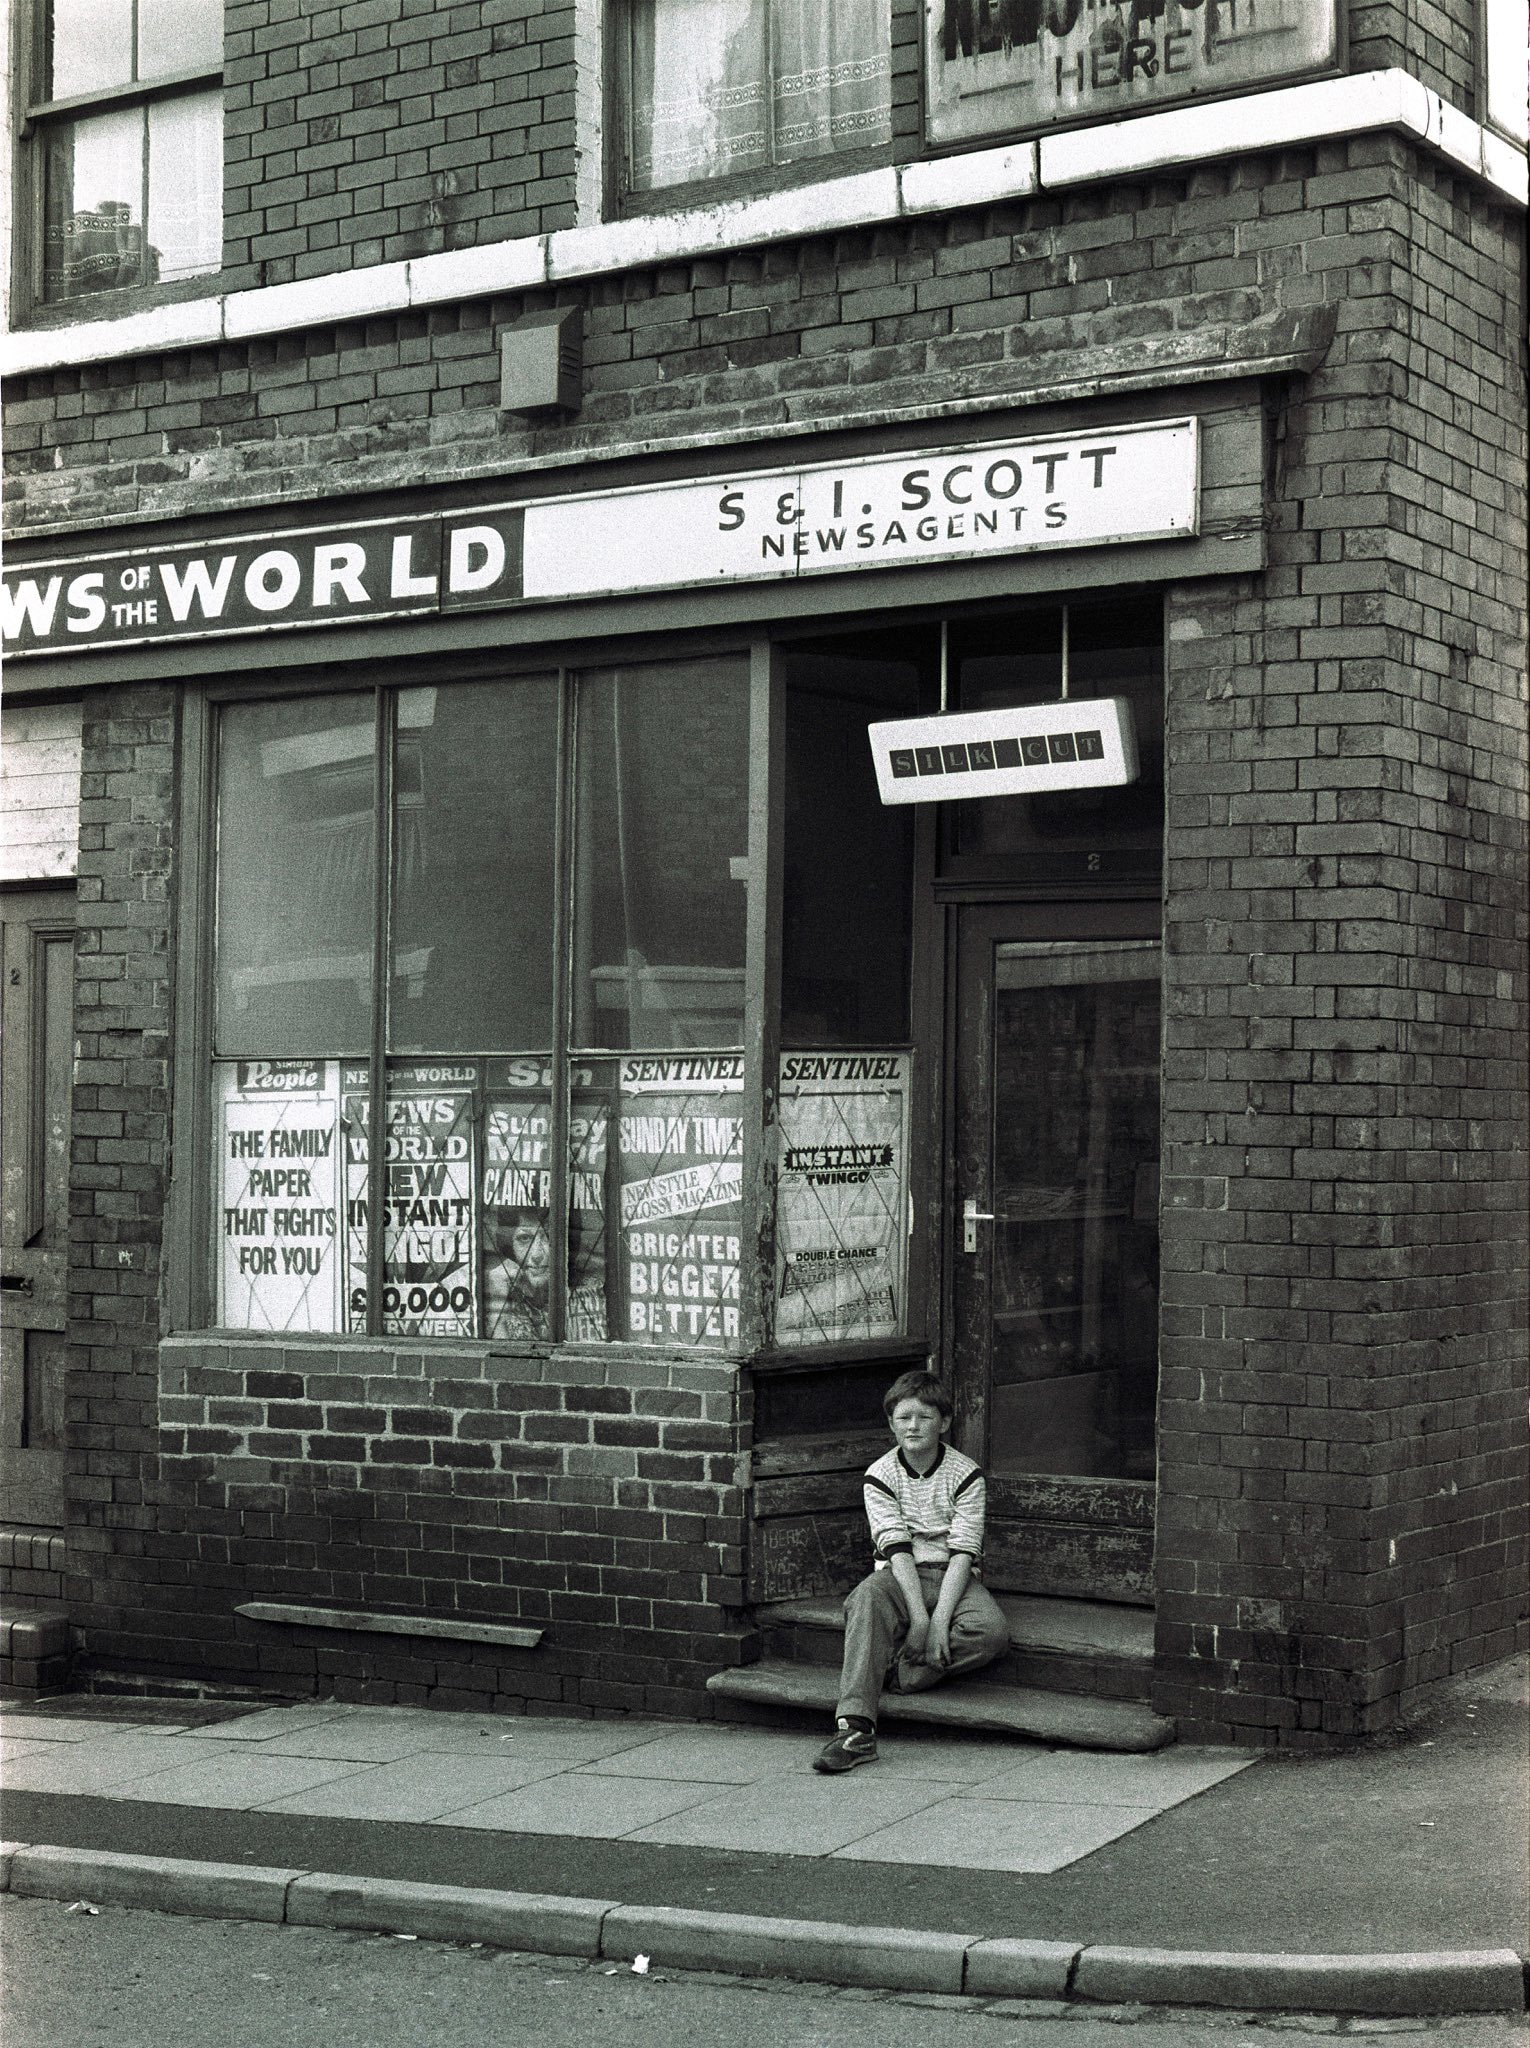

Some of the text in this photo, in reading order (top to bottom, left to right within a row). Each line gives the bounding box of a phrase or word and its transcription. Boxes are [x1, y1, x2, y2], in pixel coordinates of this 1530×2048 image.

[1055, 29, 1193, 97] HERE
[719, 492, 745, 531] S
[777, 493, 805, 525] &
[901, 447, 1117, 511] SCOTT
[762, 502, 1068, 558] NEWSAGENTS
[121, 566, 151, 591] OF
[159, 526, 505, 622] WORLD
[111, 600, 158, 627] THE
[895, 737, 1097, 773] SILK CUT
[1088, 853, 1100, 871] 2
[243, 1061, 318, 1090] People
[346, 1070, 395, 1083] NES
[414, 1067, 476, 1082] WORLD
[623, 1056, 743, 1082] SENTINEL
[781, 1057, 900, 1080] SENTINEL
[392, 1126, 420, 1136] OF THE
[488, 1111, 607, 1143] Sunay
[619, 1117, 689, 1154] SUNDAY
[229, 1129, 332, 1158] THE FAMILY
[487, 1136, 605, 1164] Miror
[791, 1148, 884, 1168] INSTANT
[249, 1168, 311, 1197] PAPER
[385, 1165, 447, 1197] EW
[483, 1168, 603, 1210] CLAIRE RNER
[625, 1171, 700, 1203] NEW STYLE
[806, 1171, 870, 1186] TWINGO
[225, 1207, 337, 1237] THAT FIGHTS
[624, 1195, 673, 1220] GLOSSY
[239, 1246, 321, 1276] FOR YOU
[349, 1230, 470, 1263] BNGO!
[630, 1233, 740, 1260] BRIGHTER
[796, 1248, 877, 1262] DOUBLE CHANCE
[630, 1262, 740, 1299] BIGGER
[351, 1286, 471, 1318] £0,000
[417, 1320, 472, 1338] WEEK
[630, 1302, 739, 1337] BETTER
